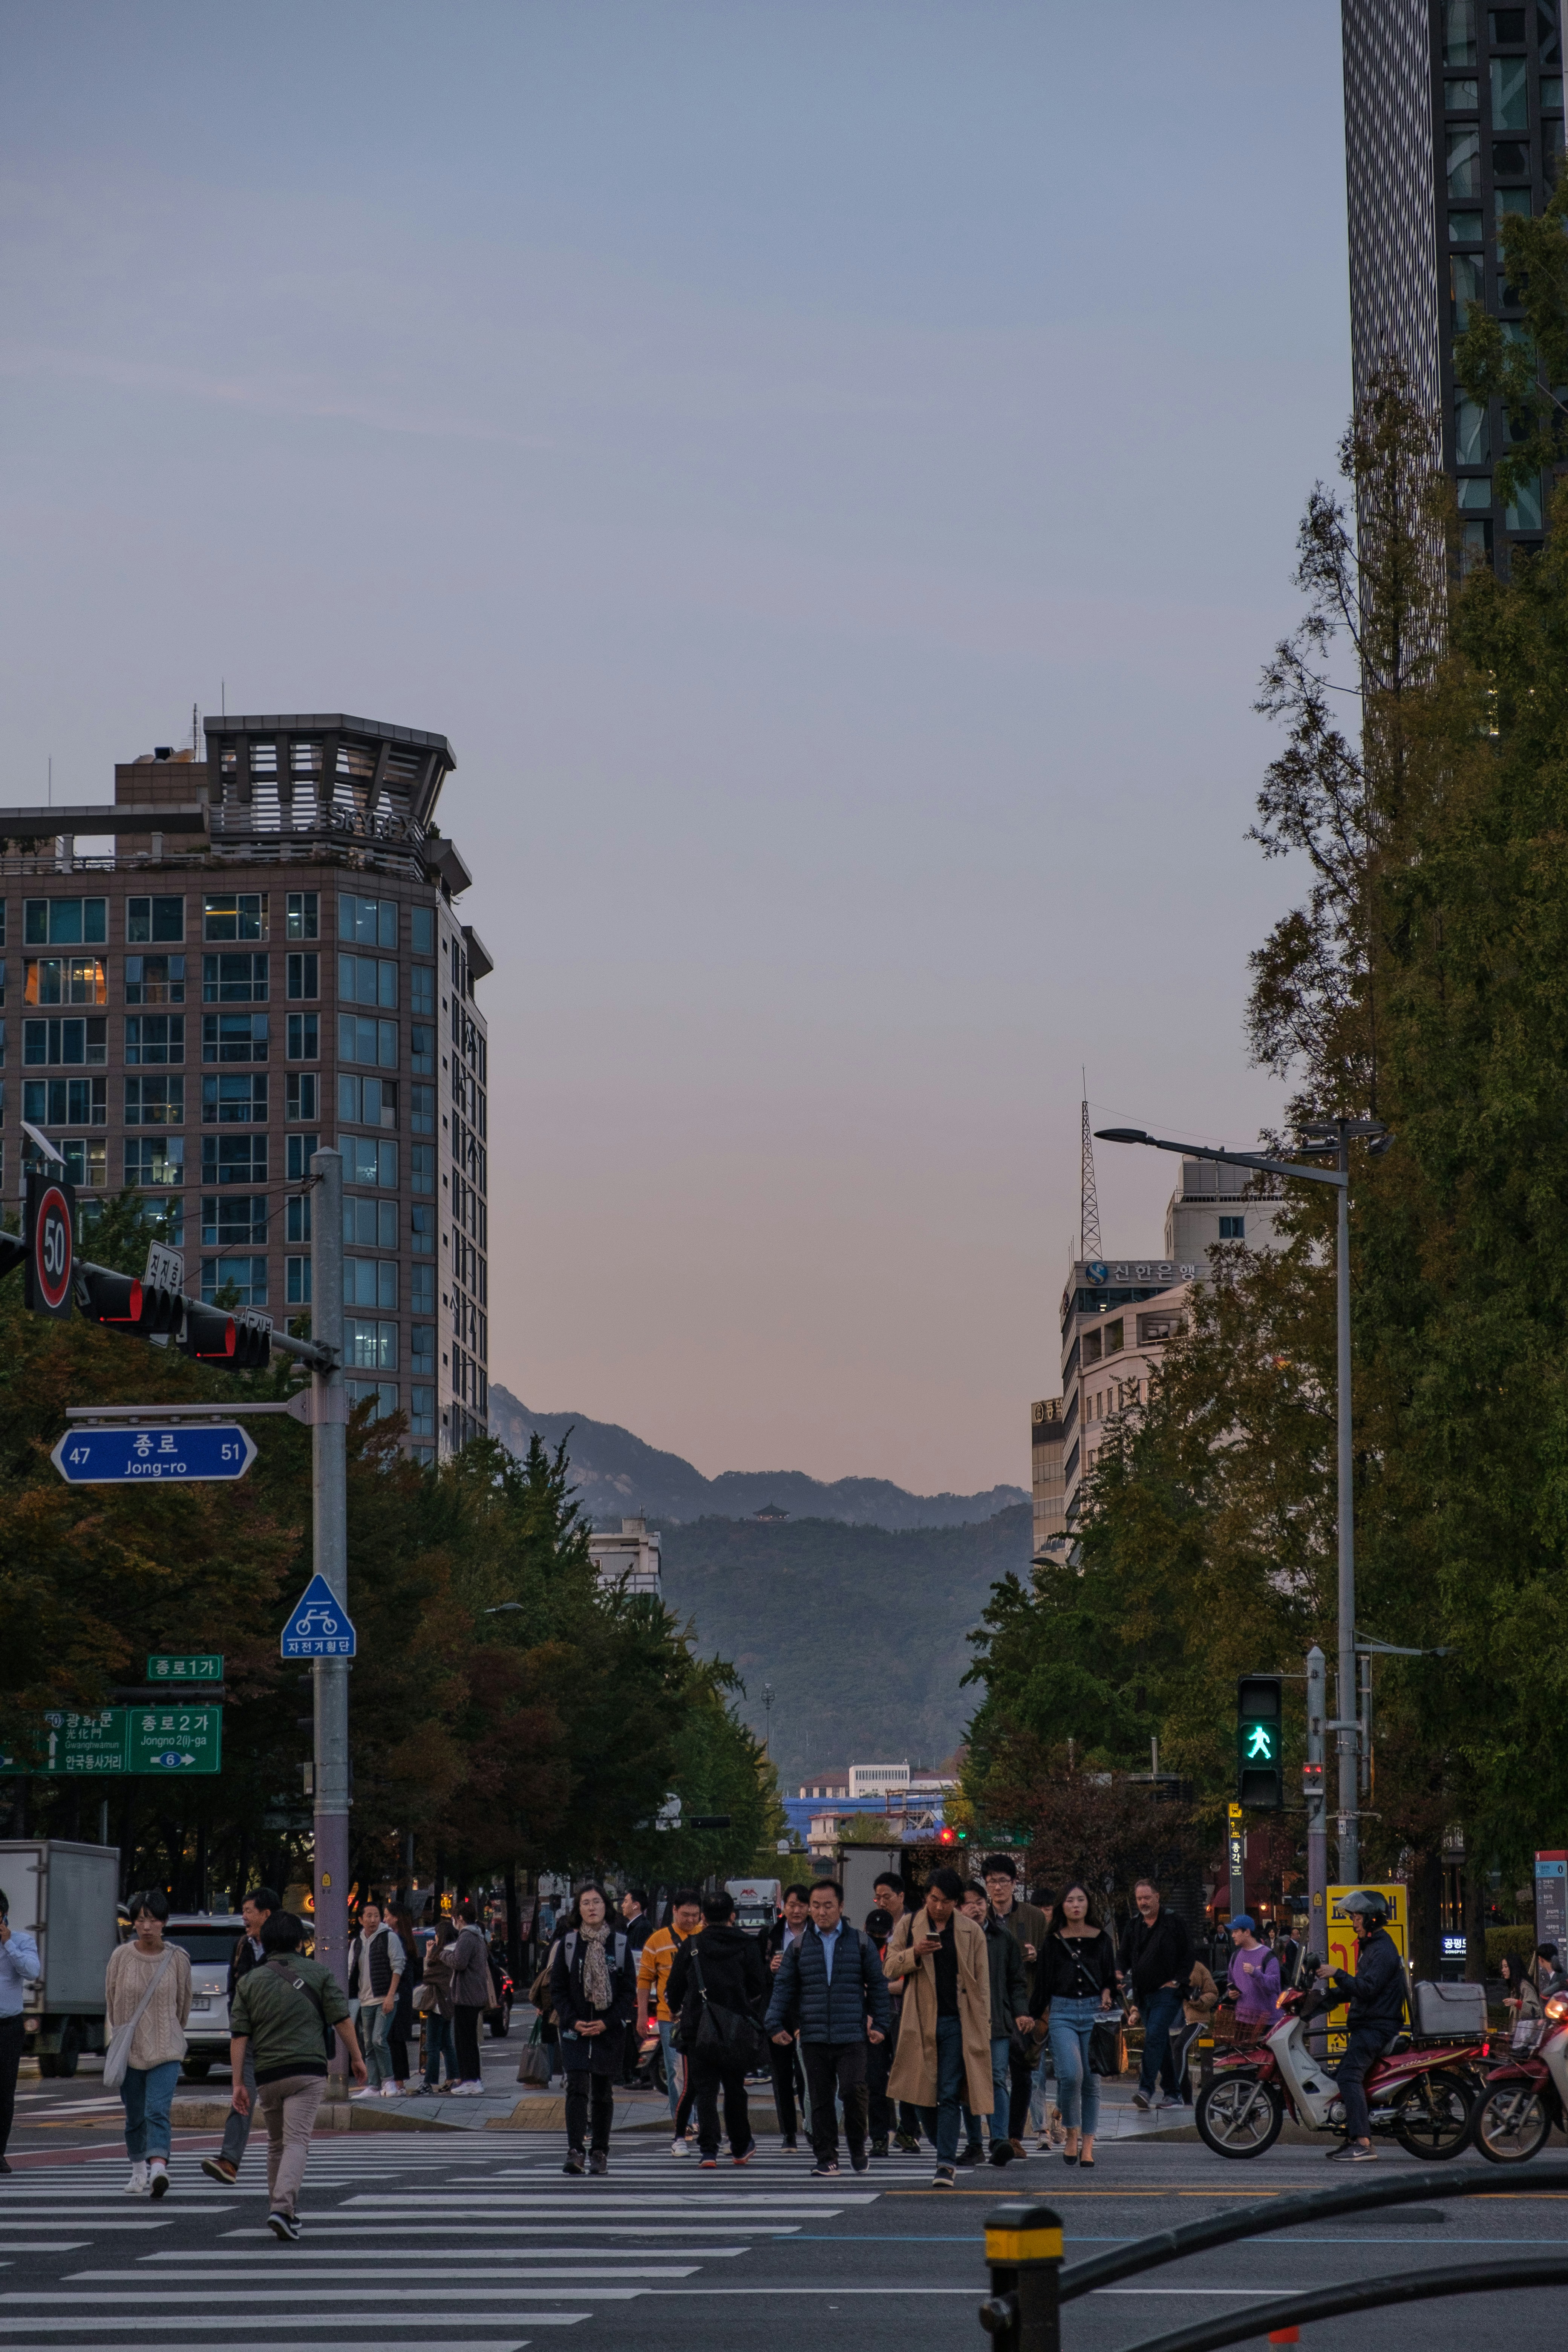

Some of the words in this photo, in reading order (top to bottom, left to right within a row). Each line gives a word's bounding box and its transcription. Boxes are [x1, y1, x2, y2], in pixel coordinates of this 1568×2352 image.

[328, 804, 418, 842] SKYREX
[44, 1218, 64, 1275] 50
[1113, 1265, 1195, 1281] 신한은행
[133, 1434, 178, 1457] 종로
[221, 1443, 239, 1460] 51
[69, 1448, 90, 1464] 47
[124, 1461, 187, 1476] Jong-ro
[288, 1641, 349, 1653] 자전거횡단
[156, 1660, 213, 1675] 종로1가
[66, 1712, 113, 1728] 광화문
[141, 1715, 208, 1732] 종로2가
[66, 1728, 102, 1739] 光化門
[141, 1735, 175, 1748] Jongno
[66, 1754, 122, 1770] 안국동사거리
[166, 1755, 175, 1766] 6
[1231, 1842, 1241, 1864] 종각
